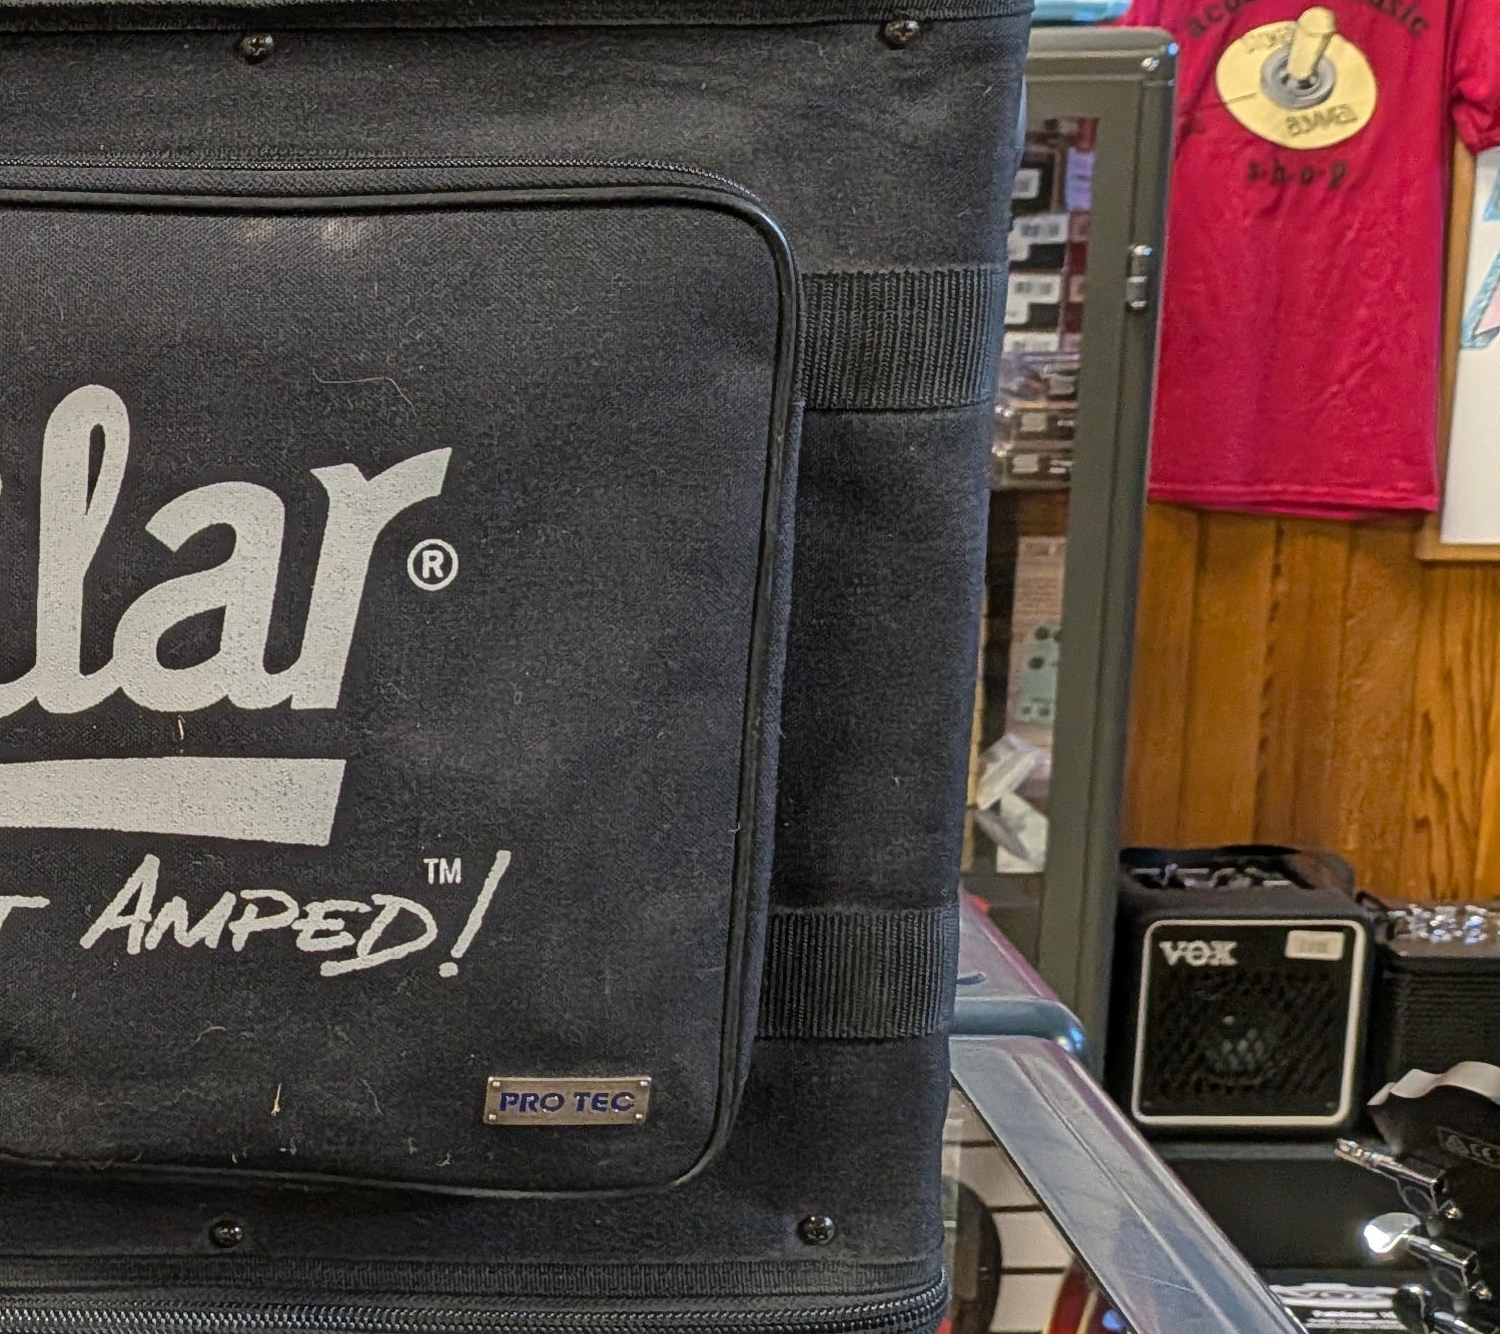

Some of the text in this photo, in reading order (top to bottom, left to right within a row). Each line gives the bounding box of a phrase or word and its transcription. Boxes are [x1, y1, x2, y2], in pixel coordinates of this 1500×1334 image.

[79, 849, 512, 978] AMPED!
[1158, 939, 1238, 967] VOX
[500, 1091, 636, 1113] PRO TEC
